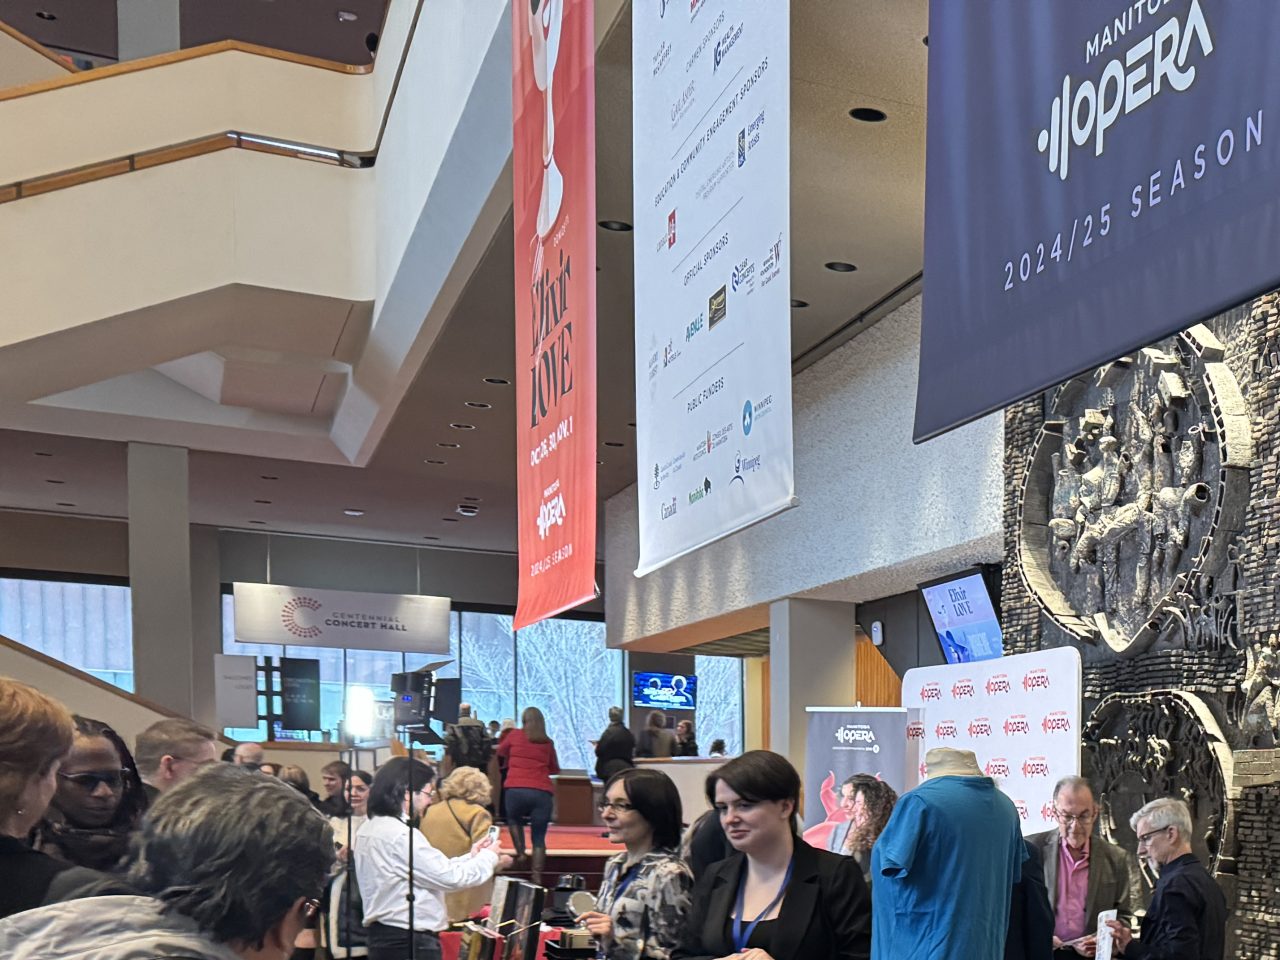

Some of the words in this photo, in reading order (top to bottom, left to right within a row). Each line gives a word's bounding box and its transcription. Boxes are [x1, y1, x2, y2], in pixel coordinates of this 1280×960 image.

[1085, 0, 1171, 64] MANITO
[1071, 0, 1214, 157] OPERA
[706, 93, 739, 142] ENGAGEMENT
[740, 56, 768, 100] SPONSORS
[1004, 203, 1111, 292] 2024/25
[1131, 109, 1263, 219] SEASON
[703, 232, 729, 266] SPONSORS
[324, 619, 377, 630] CONCERT
[380, 621, 408, 632] HALL
[332, 611, 400, 623] CENTENNIAL
[990, 680, 1011, 696] OPERA
[1027, 675, 1050, 692] OPERA
[1008, 721, 1030, 736] OPERA
[1047, 717, 1071, 734] OPERA
[843, 729, 876, 744] OPERA
[1027, 763, 1050, 778] OPERA
